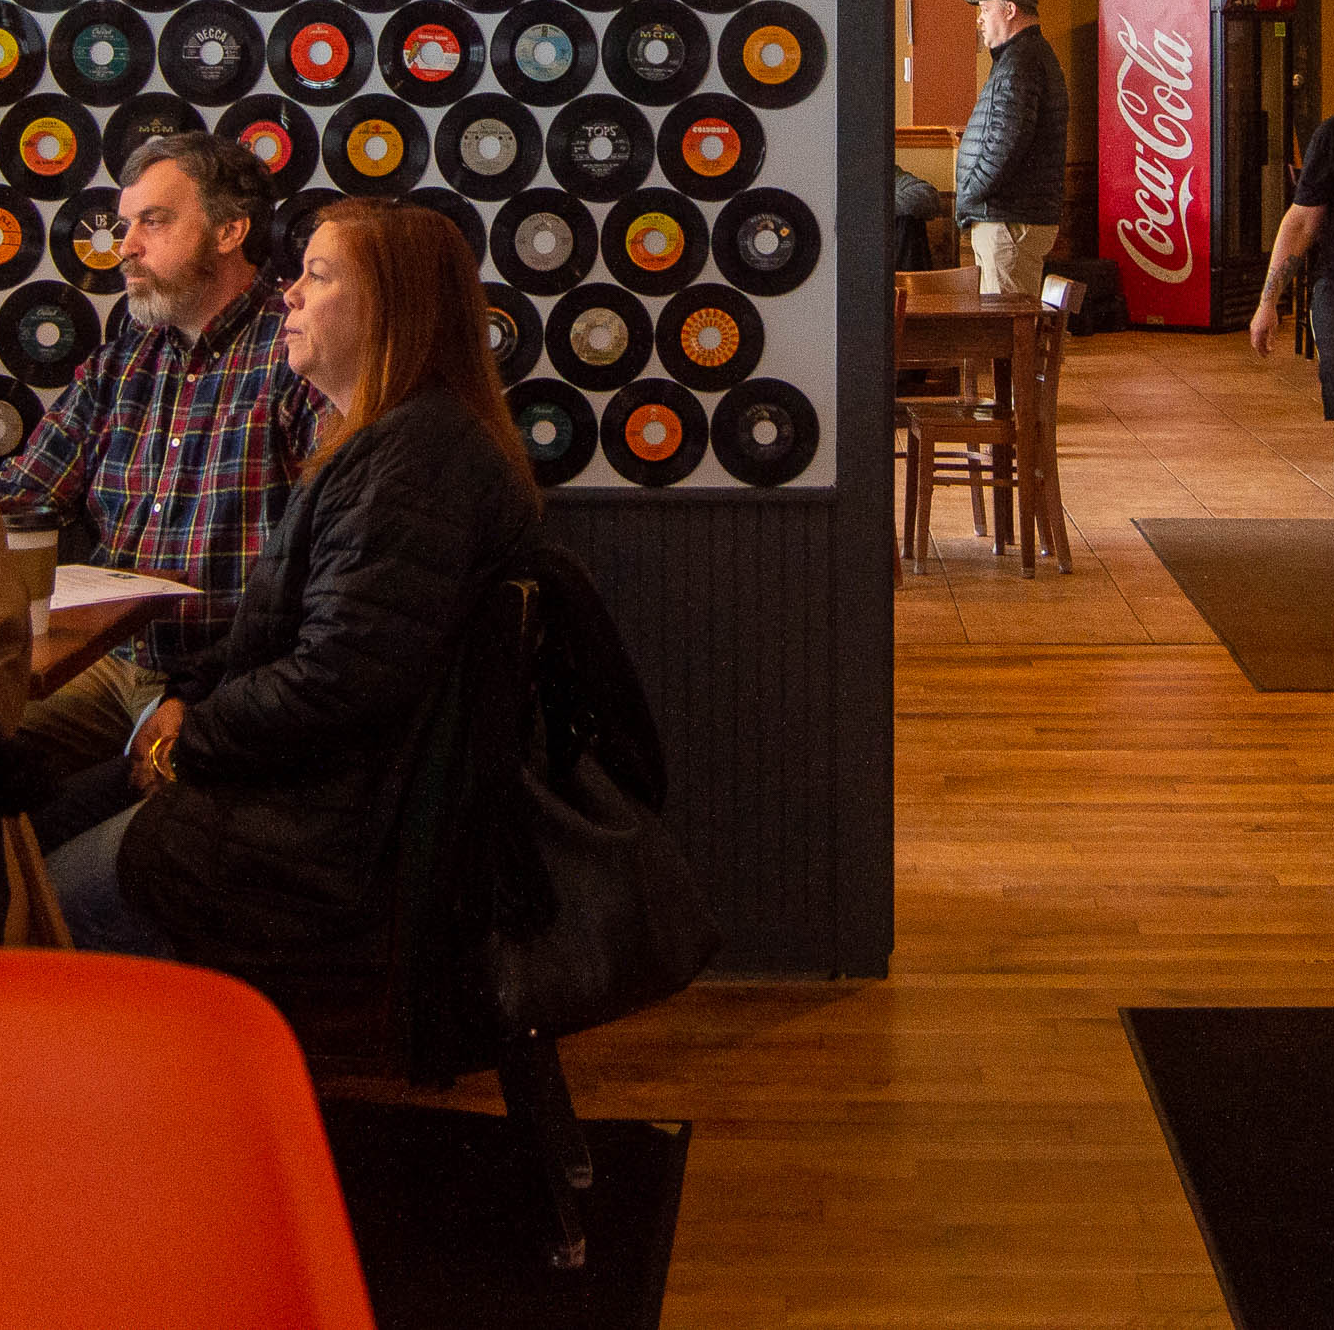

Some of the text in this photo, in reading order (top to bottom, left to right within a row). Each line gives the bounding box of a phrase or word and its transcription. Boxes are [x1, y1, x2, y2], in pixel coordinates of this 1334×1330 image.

[195, 26, 228, 43] DECCA
[640, 30, 676, 40] MGM
[1116, 13, 1195, 284] Coca-Cola
